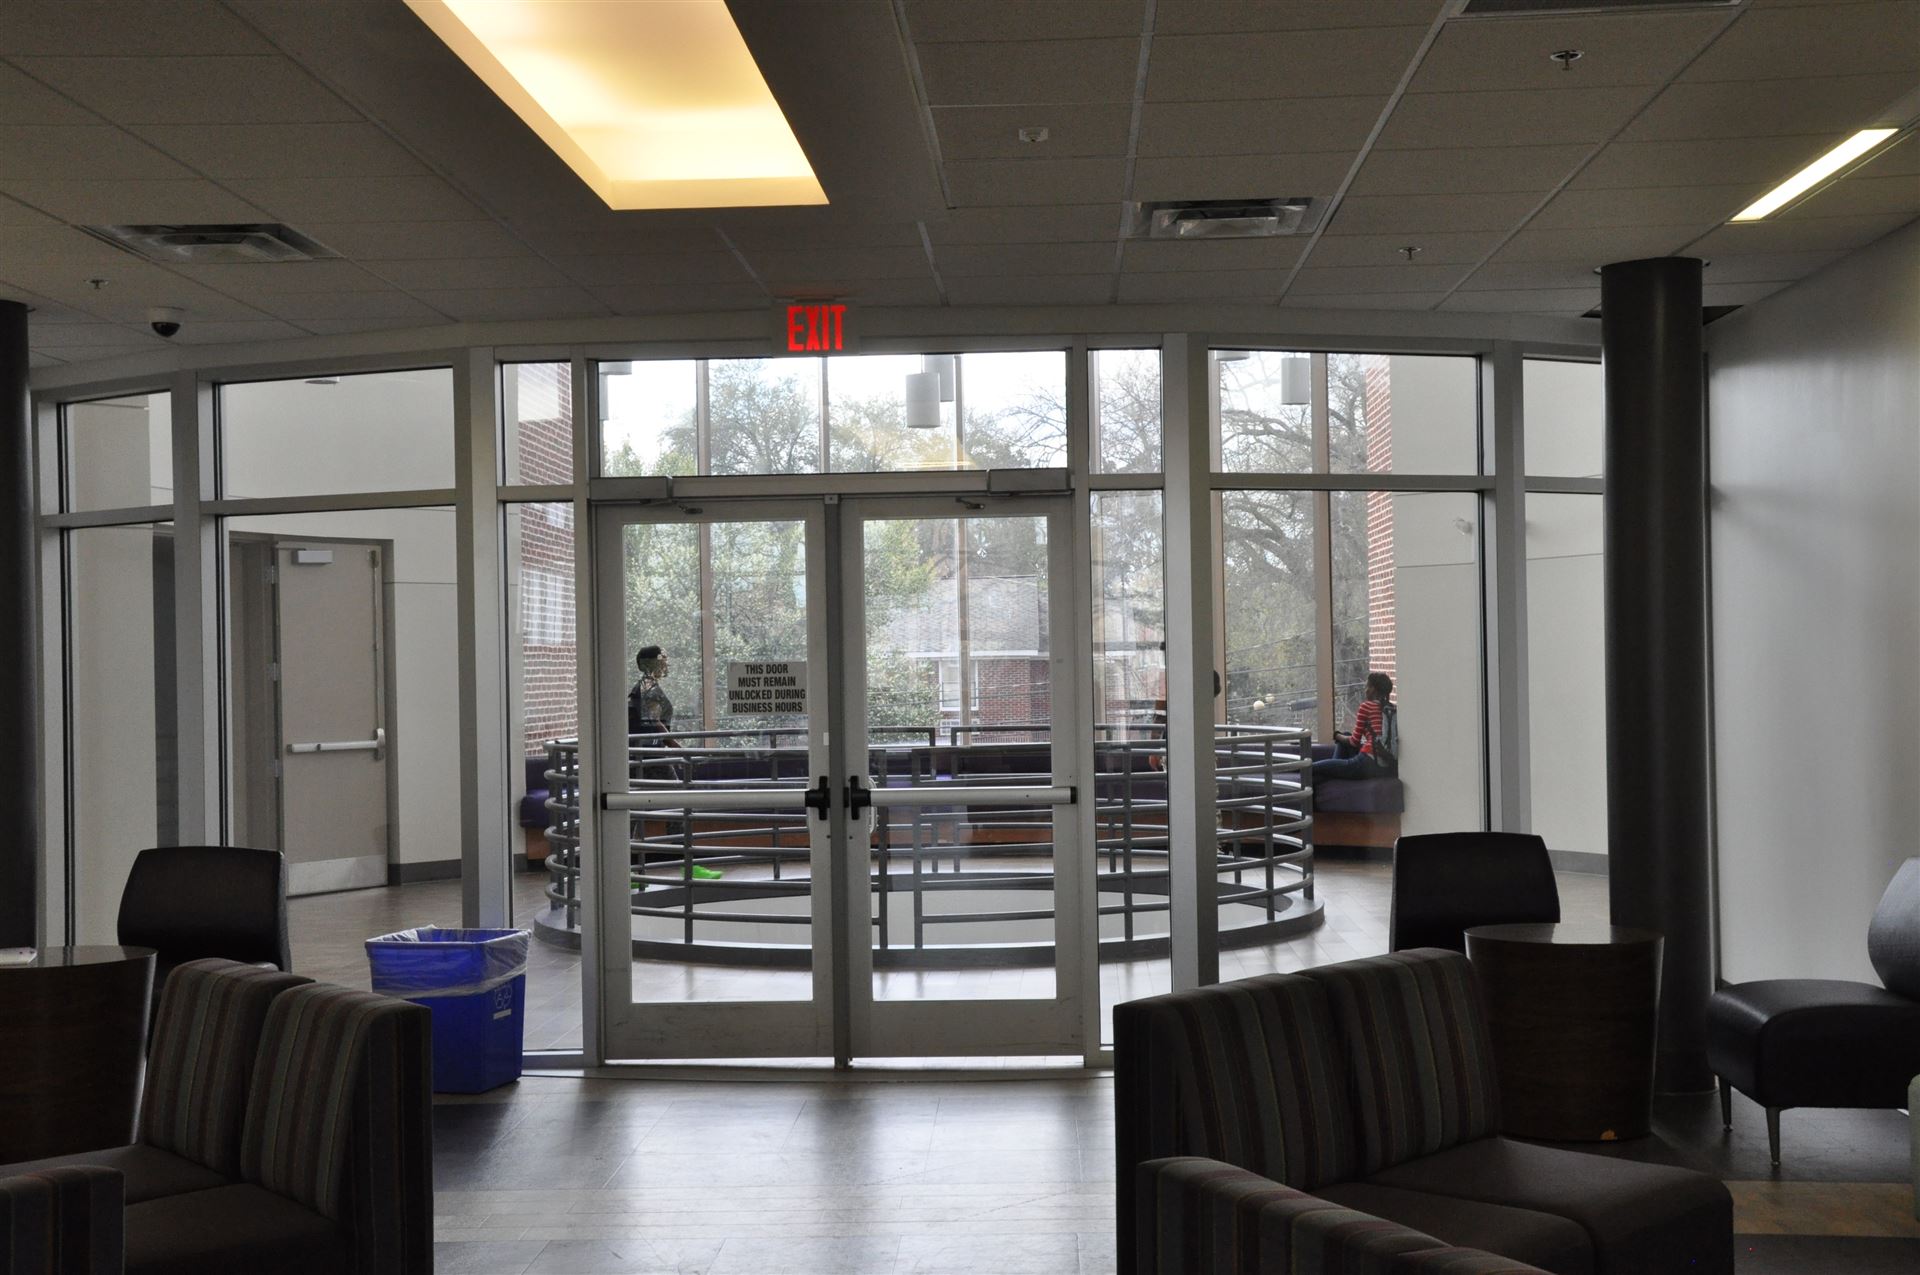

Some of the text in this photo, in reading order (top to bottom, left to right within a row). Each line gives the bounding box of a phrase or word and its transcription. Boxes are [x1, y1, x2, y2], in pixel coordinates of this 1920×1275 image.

[787, 304, 847, 352] EXIT
[745, 664, 788, 674] THIS DOOR
[738, 676, 796, 687] MUST REMAIN
[729, 689, 806, 700] UNLOCKED DURING
[732, 702, 802, 713] BUSINESS HOURS
